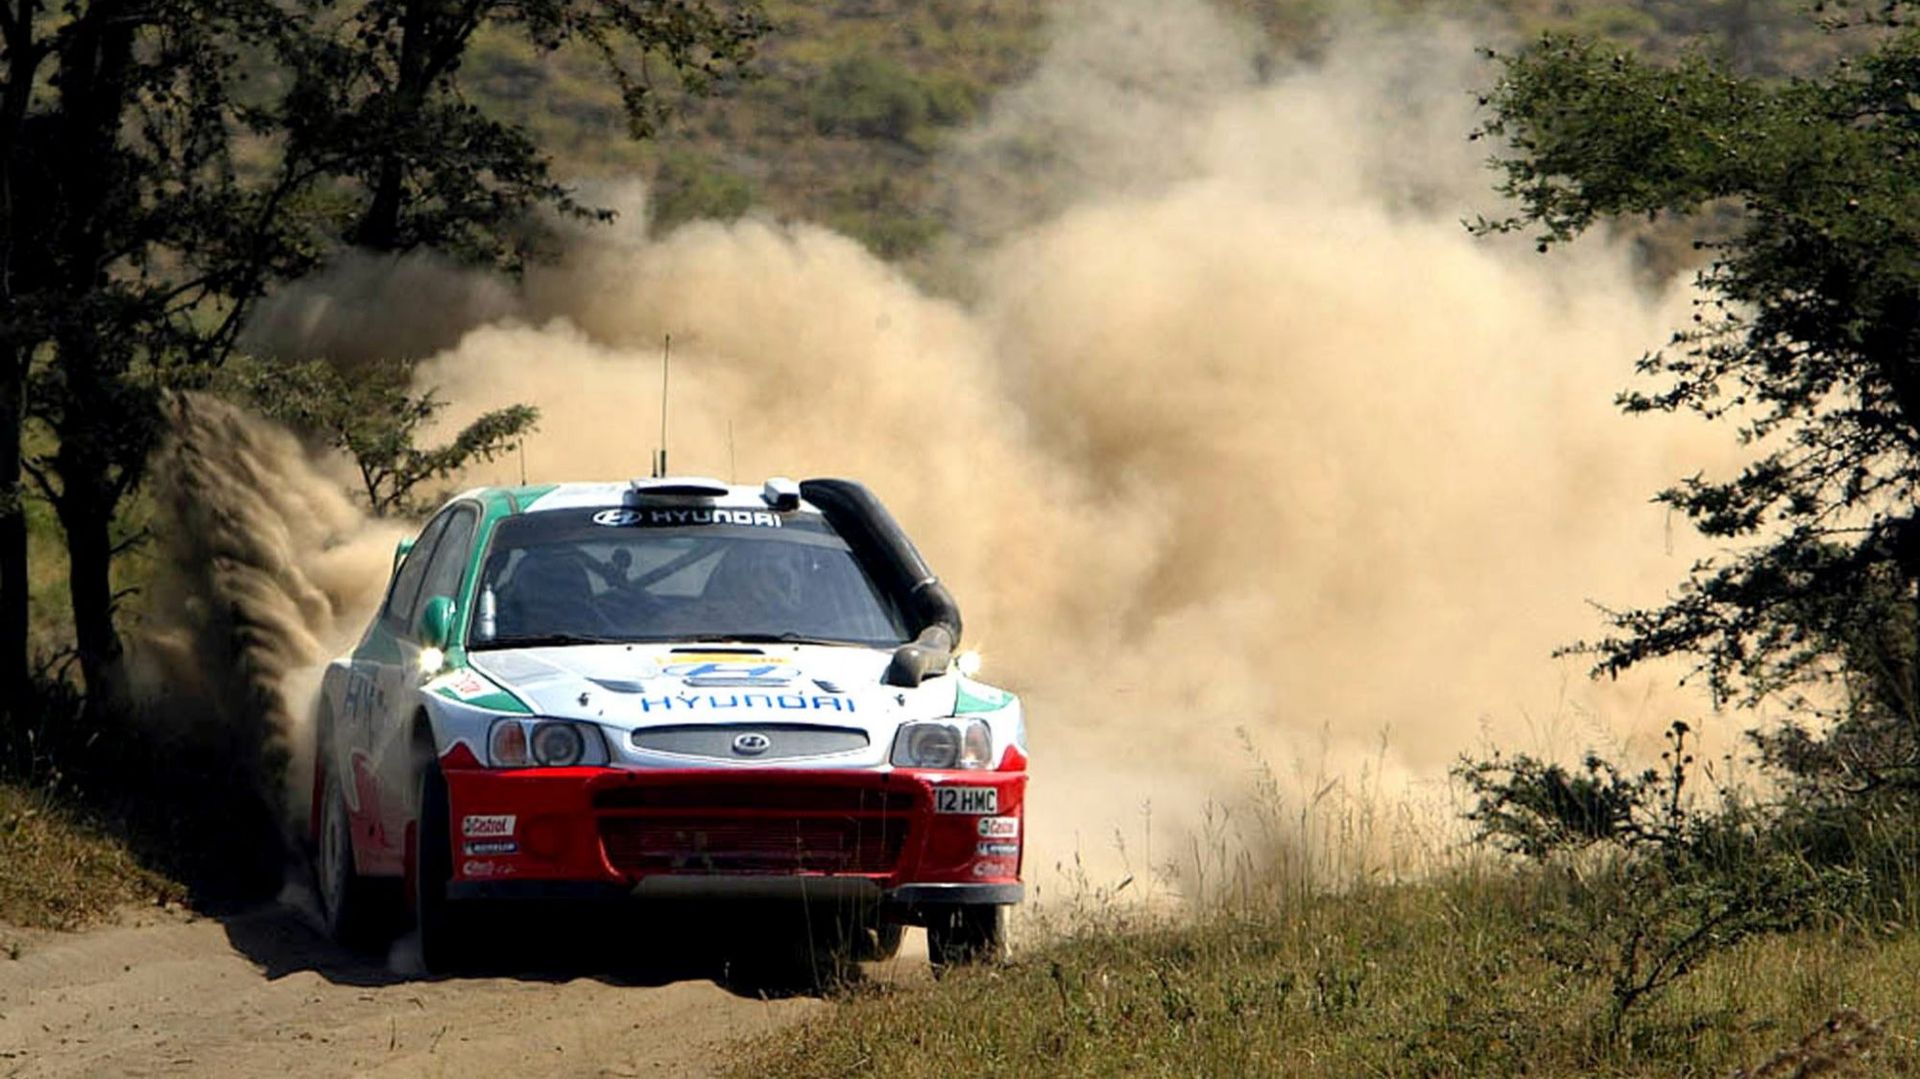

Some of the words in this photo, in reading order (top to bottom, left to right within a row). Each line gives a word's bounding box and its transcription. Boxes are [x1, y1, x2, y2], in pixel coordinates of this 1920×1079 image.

[651, 509, 783, 528] HYUNDAI
[641, 693, 856, 713] HYUNDAI
[933, 788, 957, 811] 12
[961, 789, 996, 812] HMC
